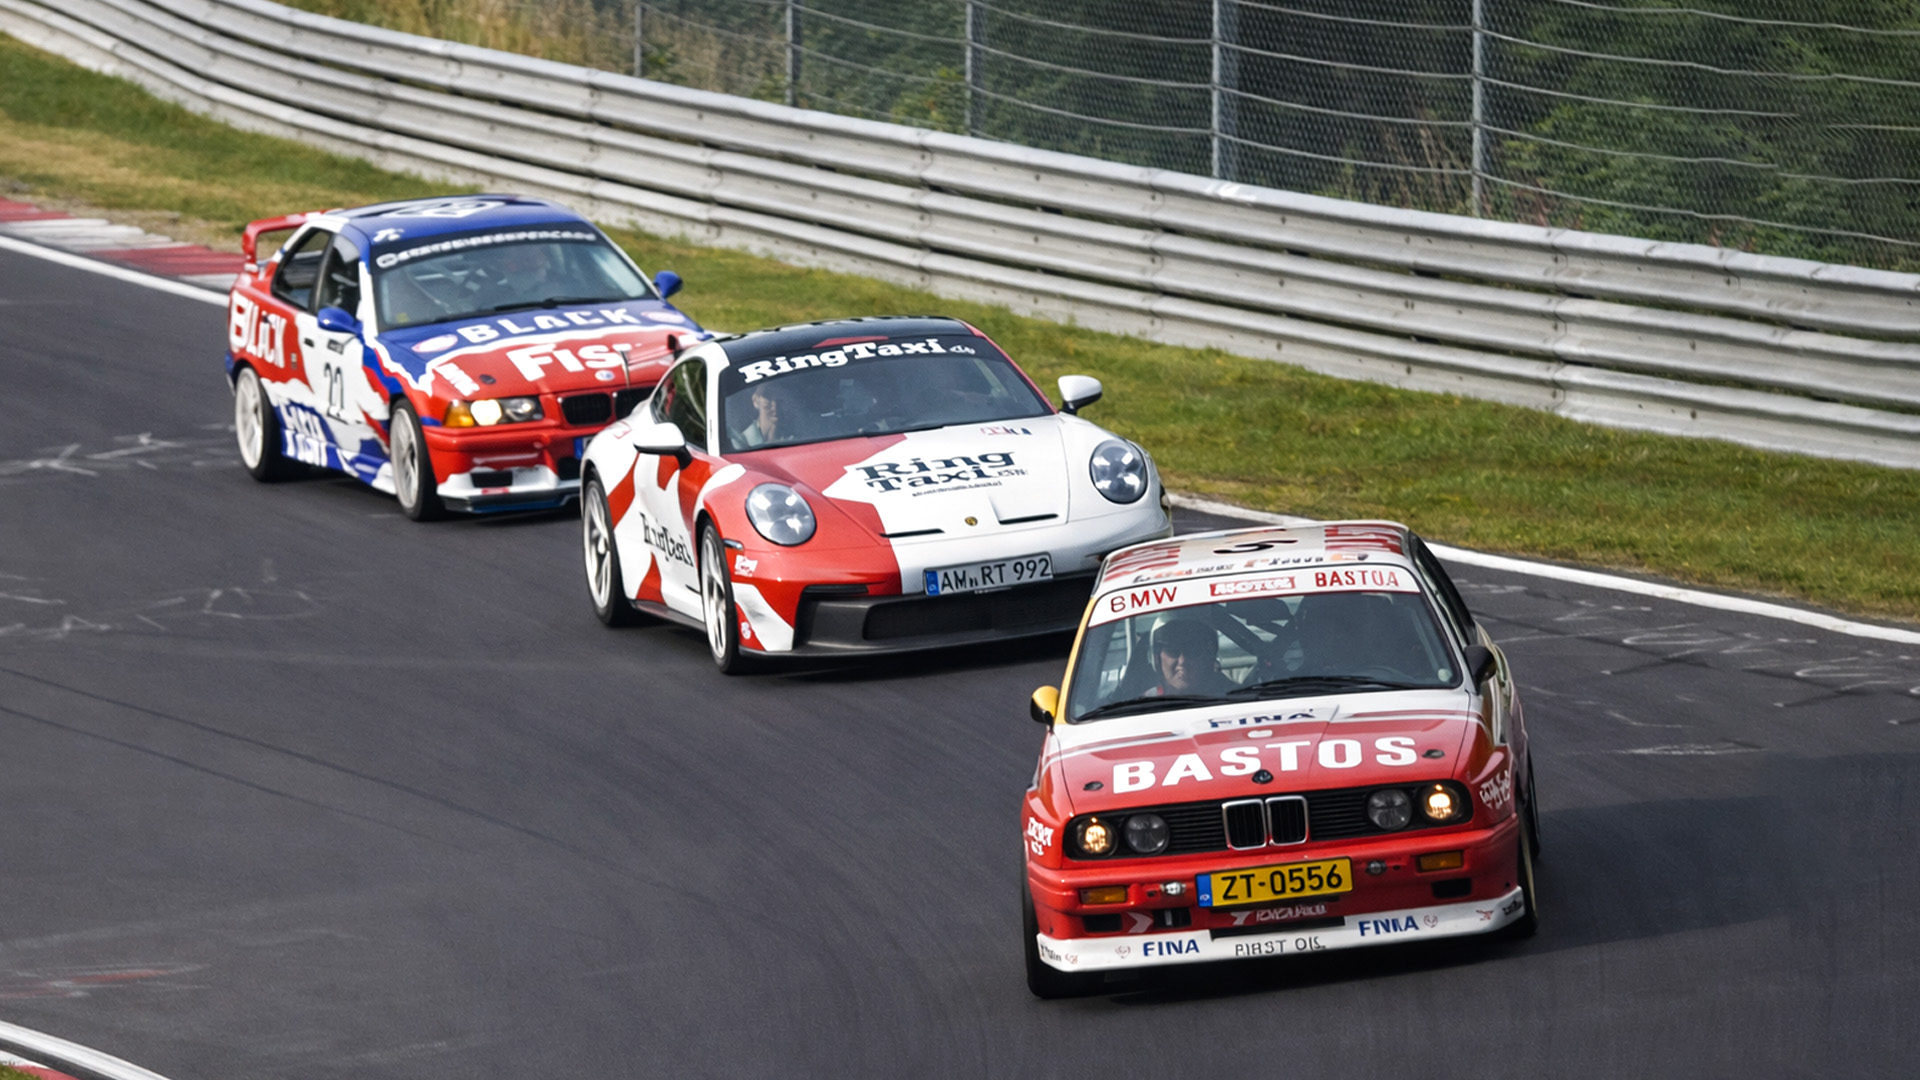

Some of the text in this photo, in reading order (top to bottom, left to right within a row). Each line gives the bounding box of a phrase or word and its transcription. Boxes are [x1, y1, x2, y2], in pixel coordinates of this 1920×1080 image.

[456, 308, 642, 343] BLACK
[738, 338, 947, 384] RingTaxi
[855, 450, 1016, 481] Ring
[866, 465, 998, 493] Taxi
[941, 557, 1052, 592] AM RT 992
[1110, 586, 1178, 613] BMW
[1112, 736, 1418, 795] BASTOS
[1220, 863, 1344, 901] ZT-0556
[1142, 938, 1200, 957] FINA
